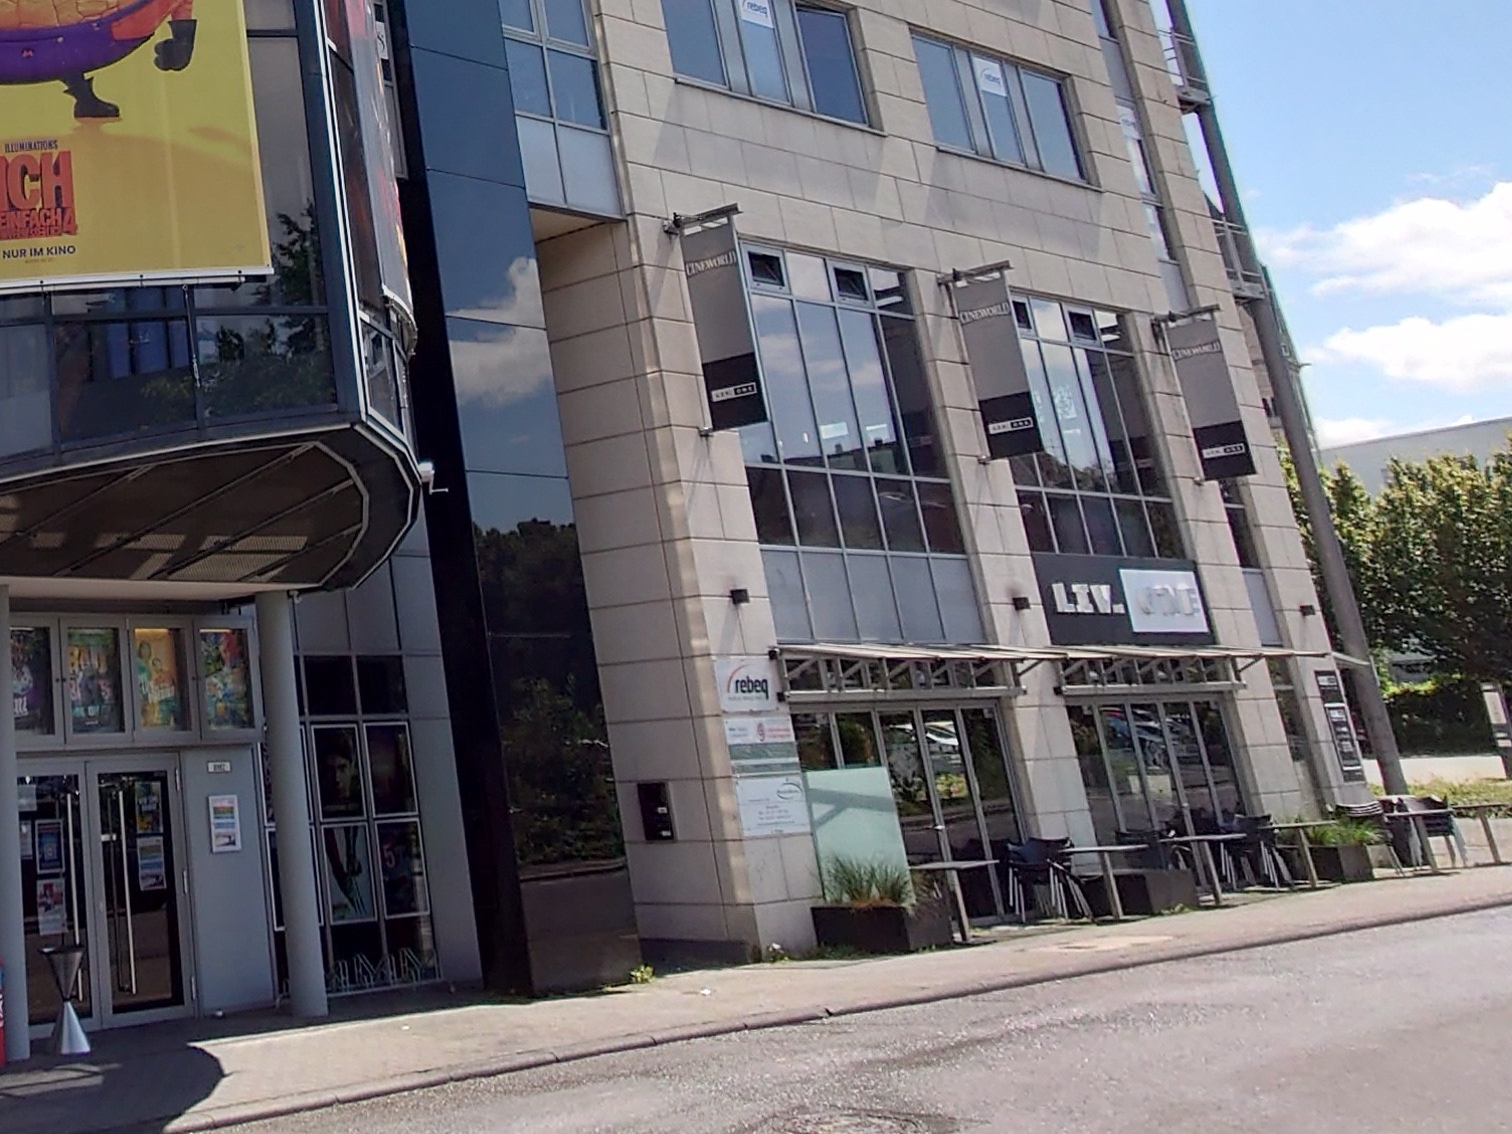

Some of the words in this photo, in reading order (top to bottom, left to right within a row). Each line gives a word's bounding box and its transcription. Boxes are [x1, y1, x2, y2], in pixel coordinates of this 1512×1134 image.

[0, 207, 62, 229] EINFACH
[62, 207, 78, 235] 4
[3, 248, 27, 259] NUR
[29, 247, 44, 257] IM
[46, 245, 76, 256] KINO
[959, 301, 1010, 324] CINEWORLD
[735, 675, 769, 700] rebeq
